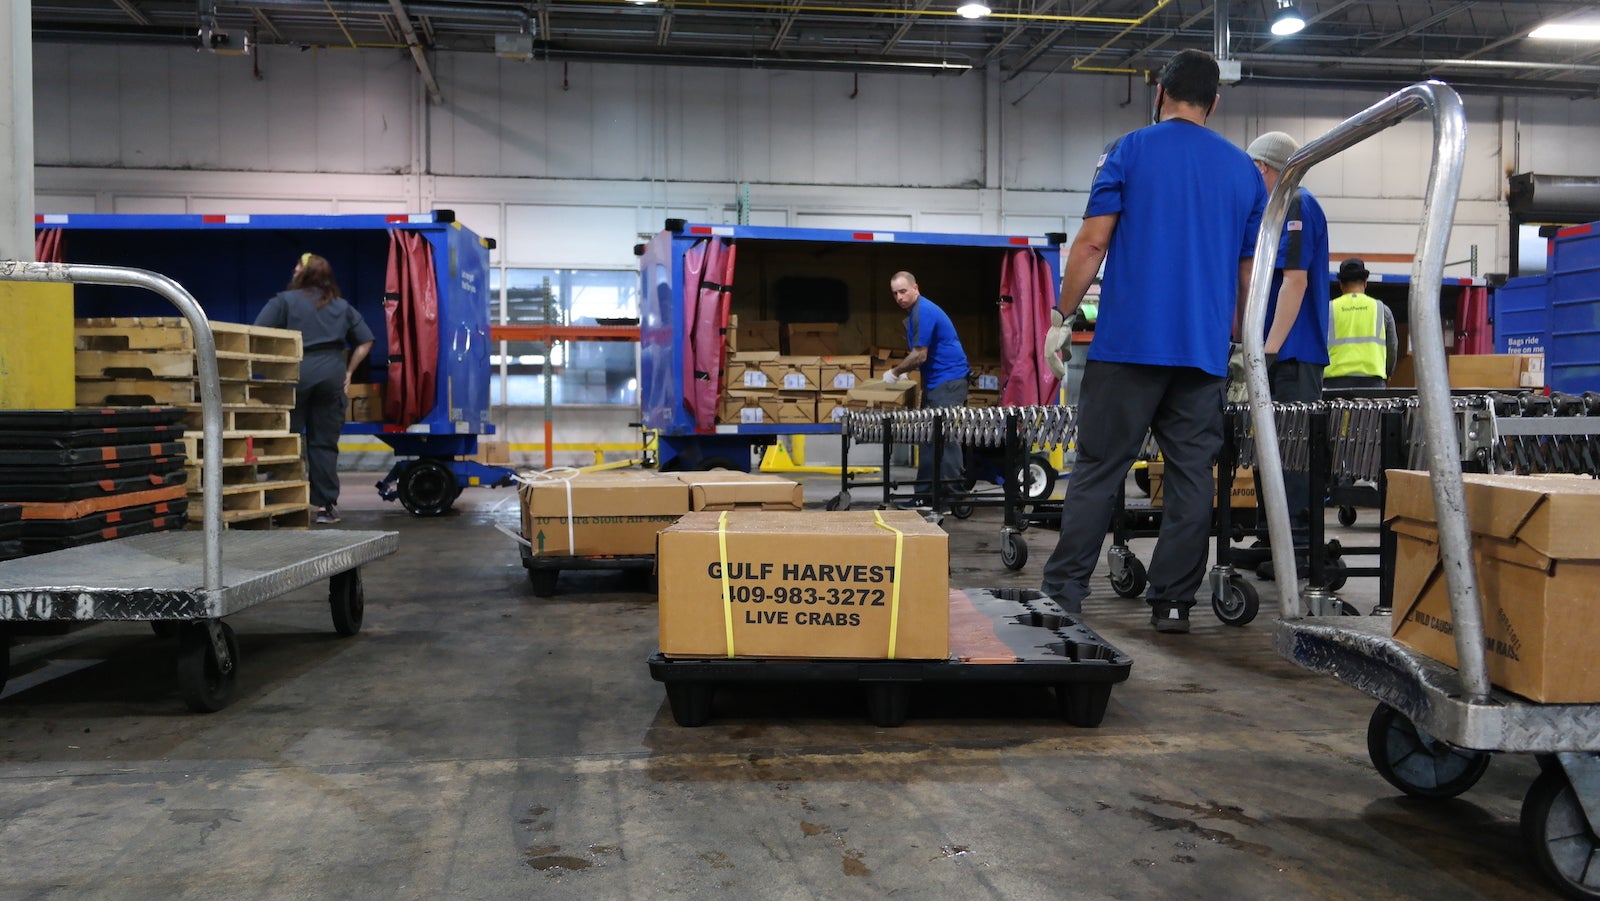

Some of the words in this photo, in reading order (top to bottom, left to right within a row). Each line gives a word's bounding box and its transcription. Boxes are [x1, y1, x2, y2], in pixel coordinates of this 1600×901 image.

[1508, 337, 1525, 347] Bags
[1525, 336, 1540, 345] ride
[1508, 346, 1522, 354] free
[560, 516, 589, 525] Utra
[708, 562, 773, 581] GULF
[782, 563, 896, 583] HARVEST
[721, 585, 885, 606] 409-983-3272
[745, 611, 788, 625] LIVE
[795, 612, 860, 626] CRABS
[1415, 610, 1430, 626] WILD
[1430, 616, 1453, 636] CAUGH
